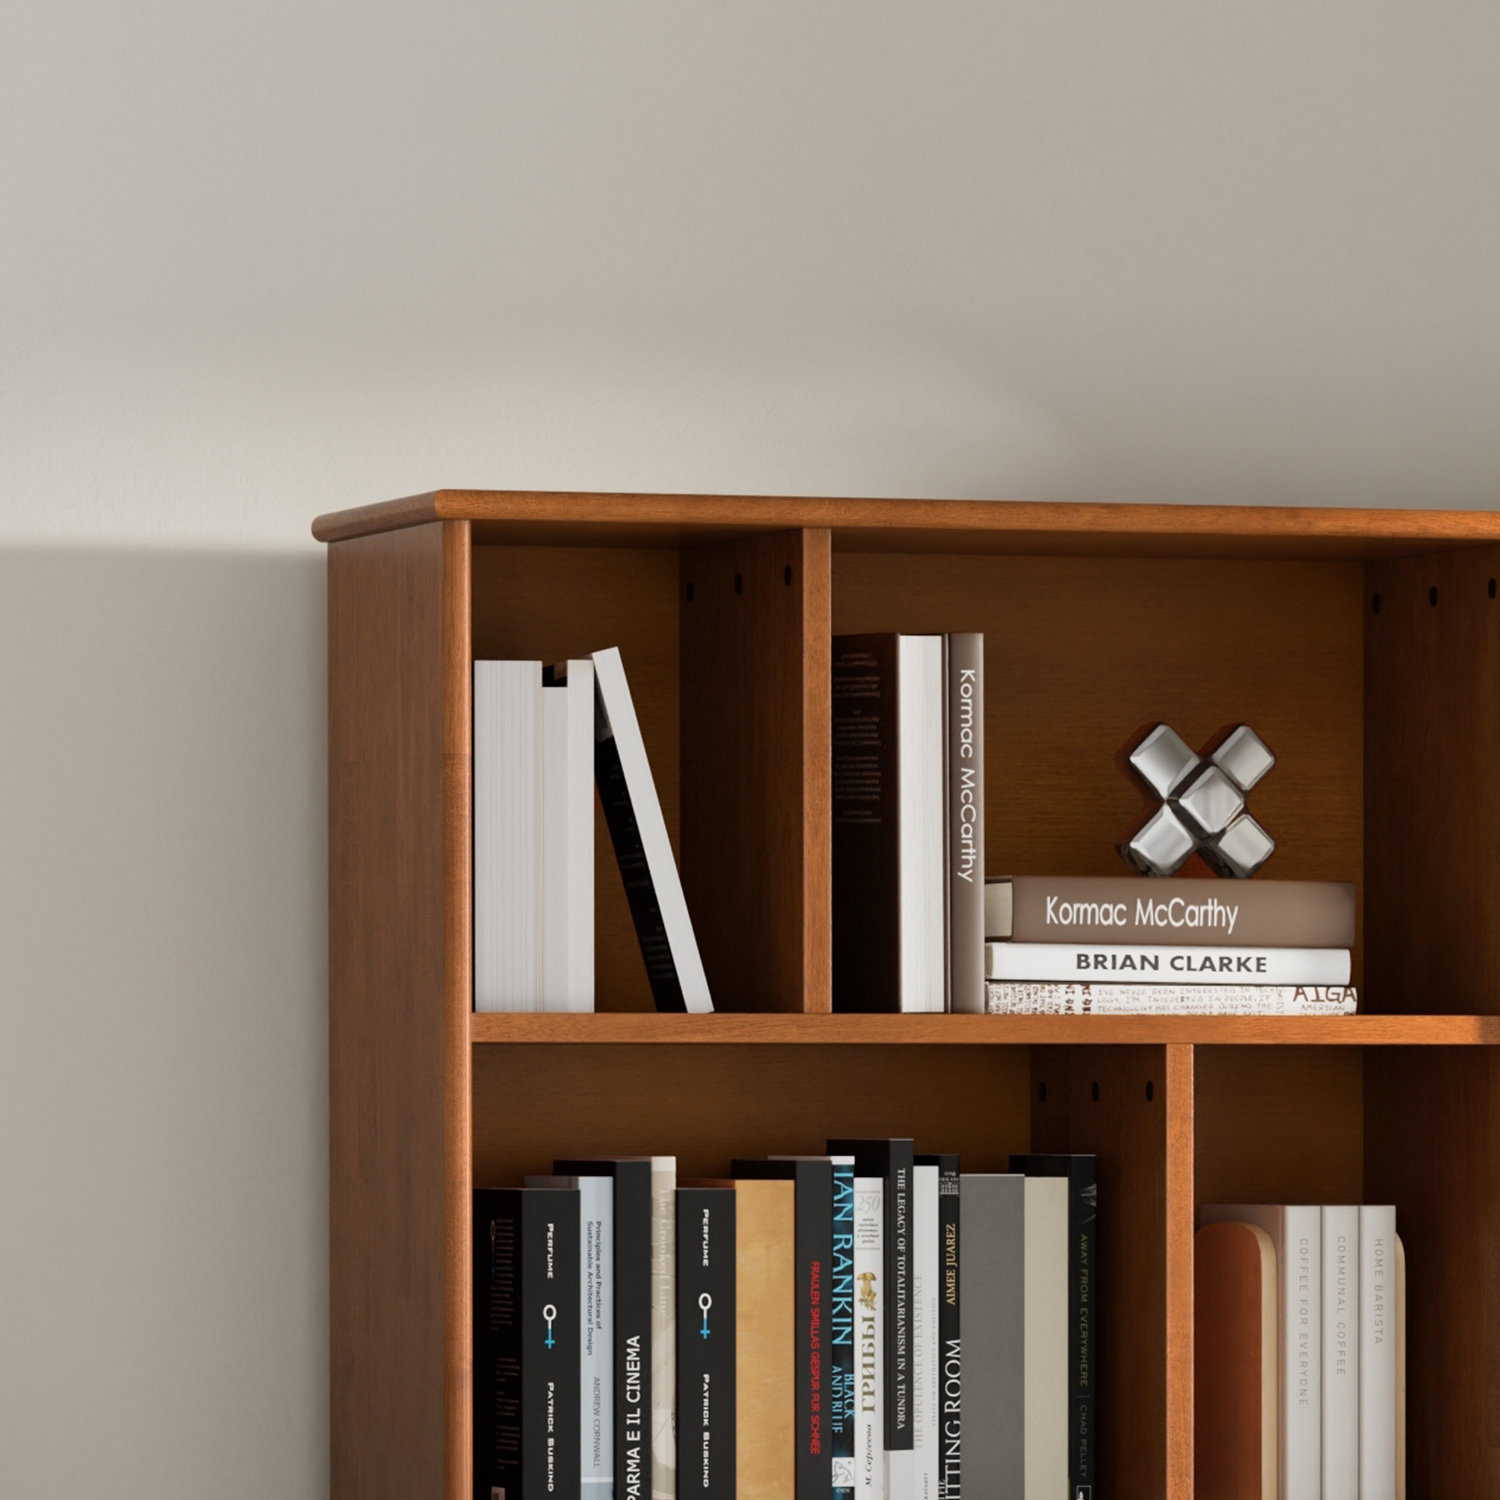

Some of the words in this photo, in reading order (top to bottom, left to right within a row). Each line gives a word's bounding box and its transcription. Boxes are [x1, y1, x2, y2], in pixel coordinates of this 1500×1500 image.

[961, 670, 977, 758] Kormac
[957, 767, 977, 882] McCarthy
[1045, 896, 1127, 926] Kormac
[1134, 897, 1239, 934] McCarthy
[1076, 953, 1160, 972] BRIAN
[1169, 955, 1268, 974] CLARKE
[1293, 986, 1357, 1004] AIGA
[832, 1171, 853, 1221] IAN
[897, 1168, 906, 1191] THE
[897, 1192, 906, 1236] LEGACY
[586, 1220, 594, 1270] Sustainable
[594, 1220, 603, 1261] Principles
[897, 1237, 906, 1253] OF
[946, 1223, 957, 1267] JUAREZ
[1079, 1233, 1088, 1266] AWAY
[1374, 1238, 1384, 1277] HOME
[595, 1263, 603, 1279] and
[947, 1269, 956, 1305] AIMEE
[1079, 1268, 1088, 1303] FROM
[1299, 1238, 1309, 1292] COFFEE
[1336, 1235, 1346, 1315] COMMUNAL
[586, 1271, 594, 1325] Architectural
[595, 1281, 603, 1319] Practices
[832, 1233, 853, 1345] RANKIN
[897, 1254, 906, 1355] TOTALITARIANISM
[913, 1273, 924, 1339] EXISTENCE
[595, 1321, 603, 1330] of
[1299, 1299, 1309, 1326] FOR
[1374, 1284, 1384, 1345] BARISTA
[585, 1327, 594, 1356] Design
[1079, 1307, 1088, 1387] EVERYWHERE
[1336, 1321, 1346, 1376] COFFEE
[626, 1335, 641, 1403] CINEMA
[861, 1314, 876, 1414] ГРИБЫ
[897, 1358, 906, 1370] IN
[897, 1373, 906, 1381] A
[944, 1339, 961, 1414] ROOM
[1299, 1332, 1309, 1406] EVERYONE
[547, 1382, 555, 1432] PATRICK
[592, 1376, 600, 1416] ANDREW
[626, 1408, 641, 1425] IL
[702, 1374, 710, 1426] PATRICK
[844, 1373, 855, 1419] BLACK
[897, 1383, 906, 1429] TUNDRA
[626, 1430, 641, 1441] E
[1079, 1404, 1088, 1435] CHAD
[592, 1418, 600, 1468] CORNWALL
[1079, 1438, 1088, 1478] PELLEY
